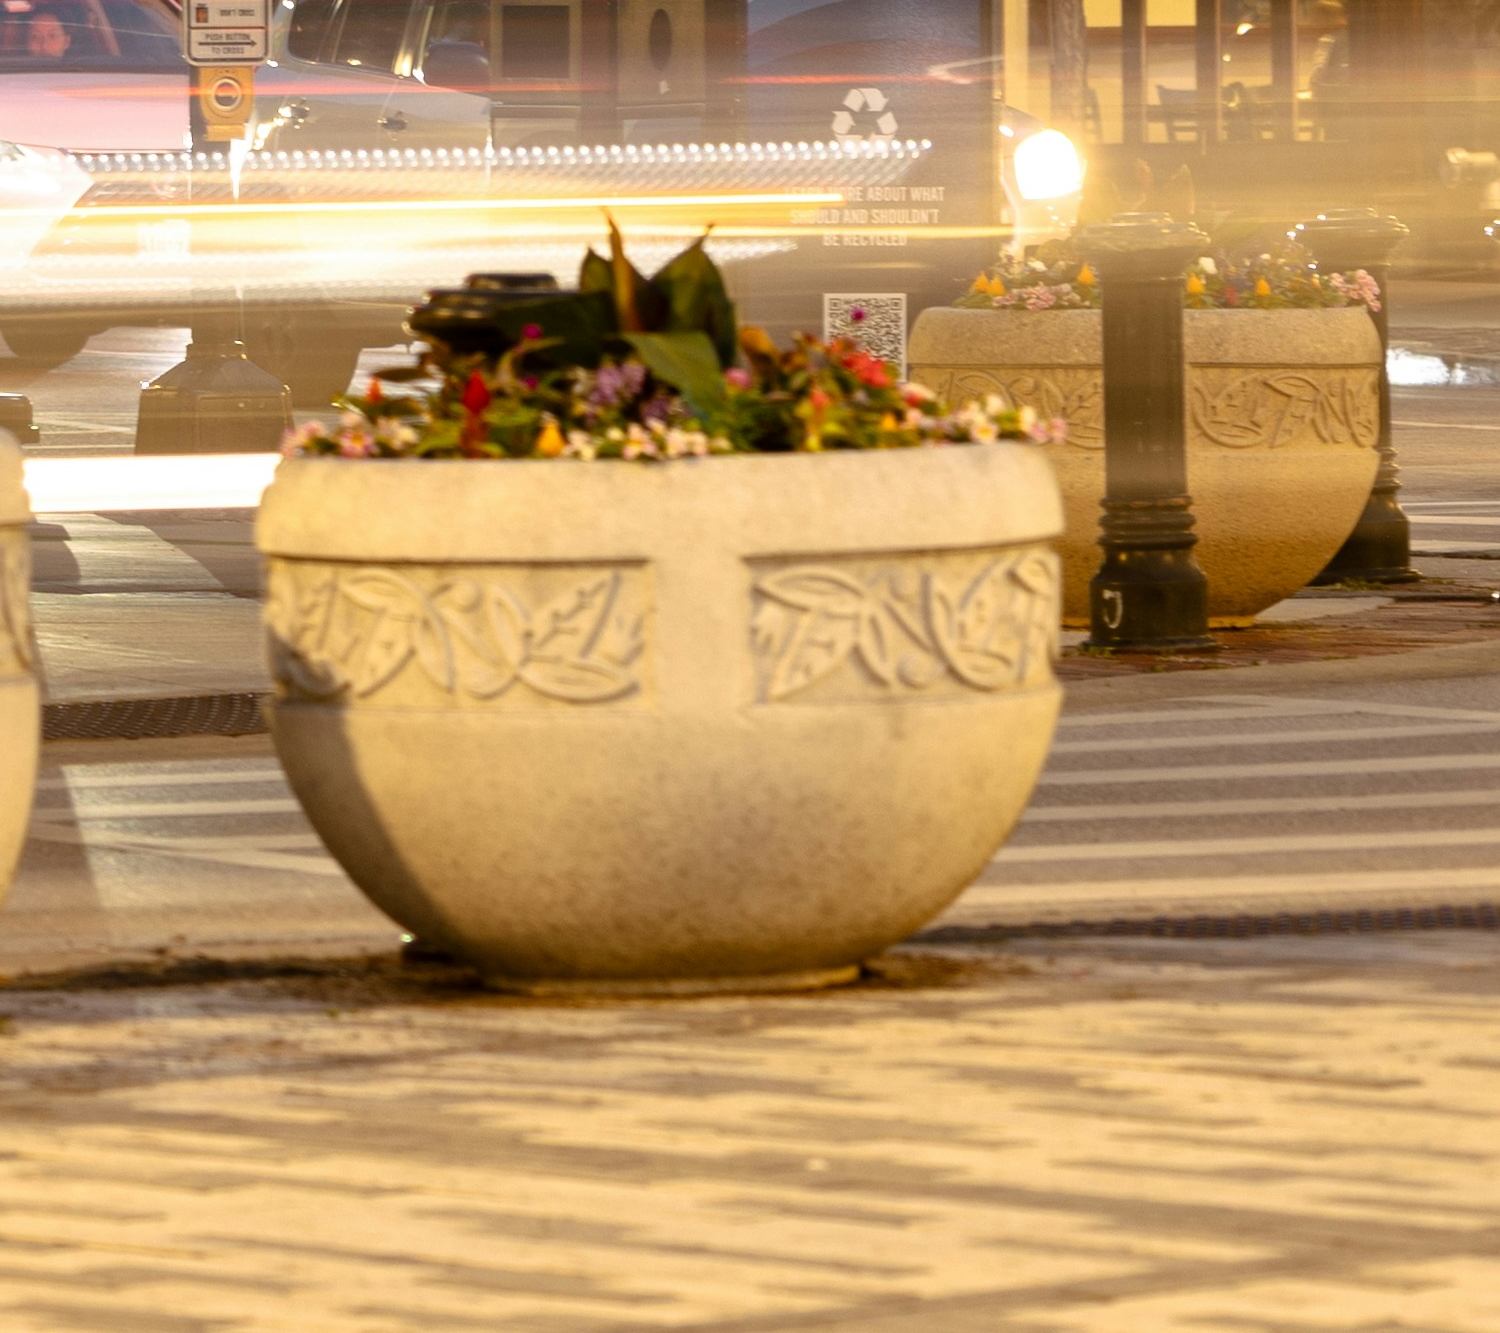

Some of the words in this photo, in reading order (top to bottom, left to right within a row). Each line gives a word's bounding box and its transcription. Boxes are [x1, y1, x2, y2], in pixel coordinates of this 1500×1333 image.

[866, 186, 908, 202] ABOUT
[910, 186, 945, 202] WHAT
[790, 208, 841, 225] SHOULD
[843, 208, 869, 225] AND
[871, 208, 941, 225] SHOULDN'T
[842, 230, 909, 247] RECYCLED
